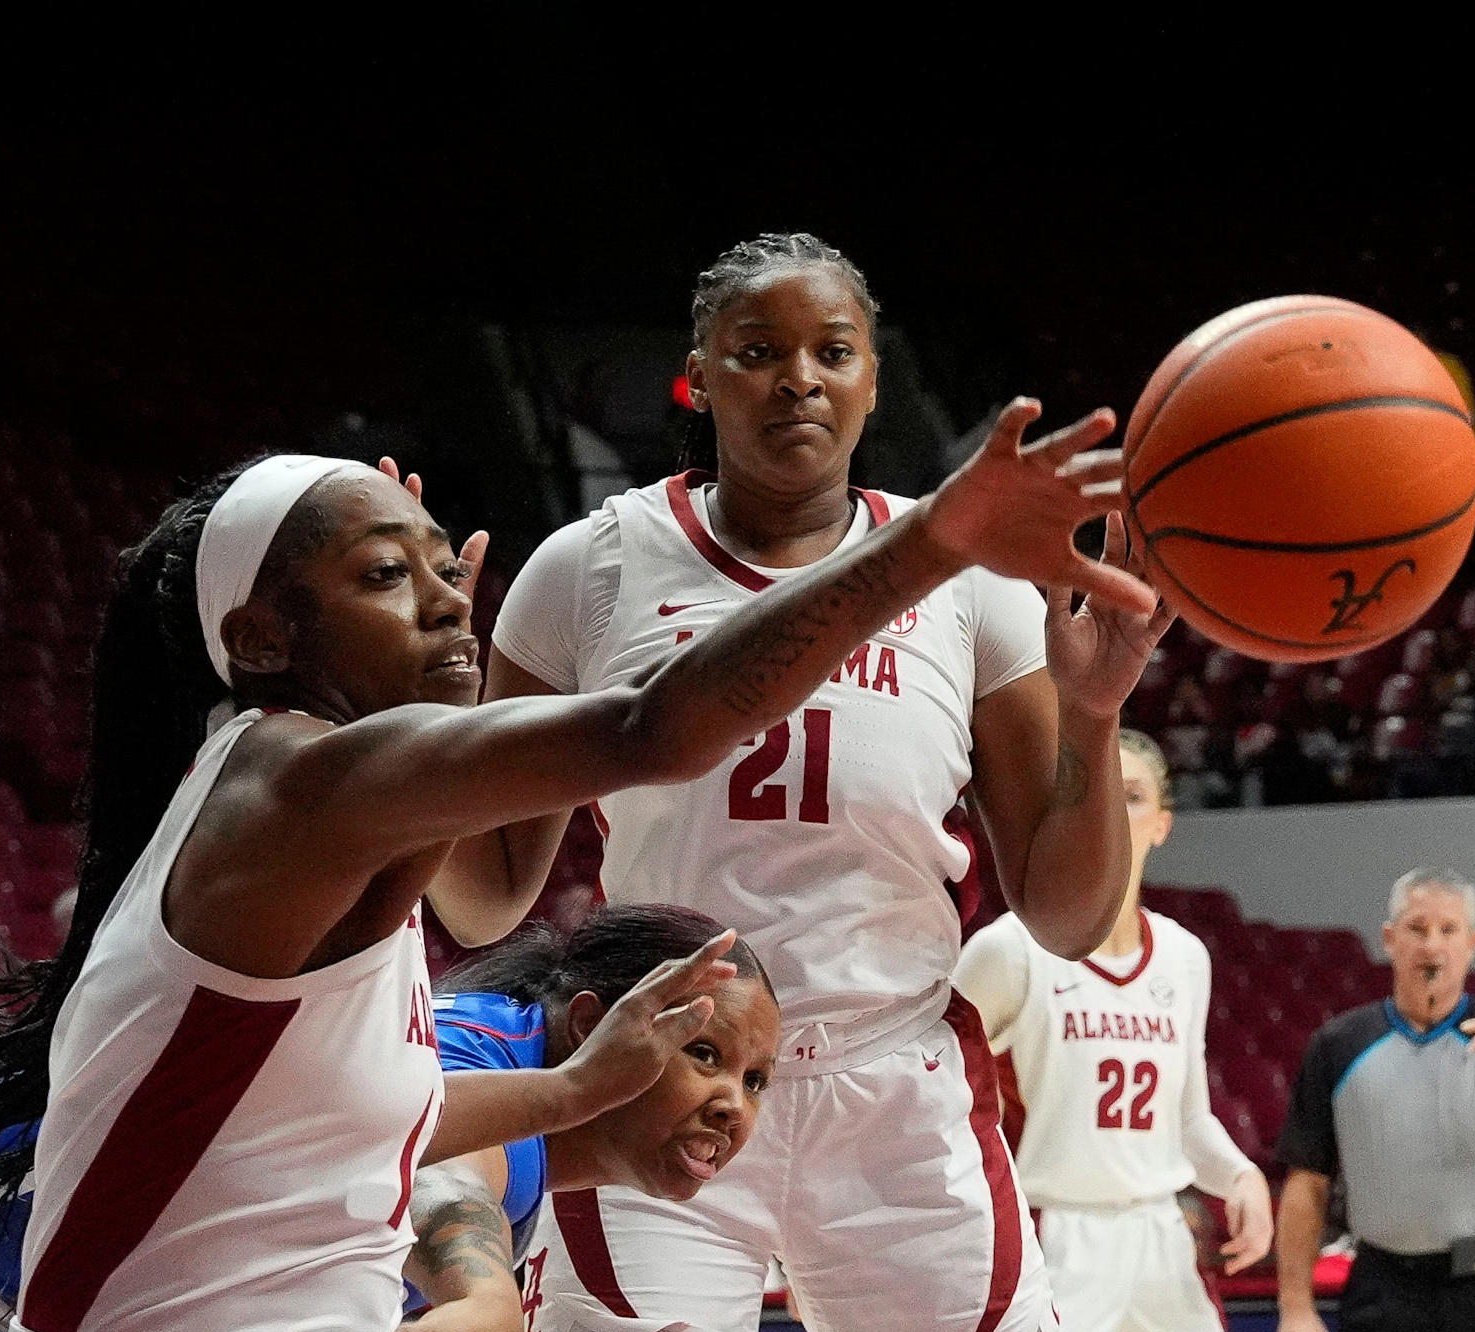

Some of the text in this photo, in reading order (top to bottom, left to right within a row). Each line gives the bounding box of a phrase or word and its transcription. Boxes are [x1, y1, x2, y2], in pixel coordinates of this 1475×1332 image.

[729, 708, 831, 824] 21
[1062, 1010, 1178, 1043] ALABAMA
[1097, 1058, 1158, 1130] 22
